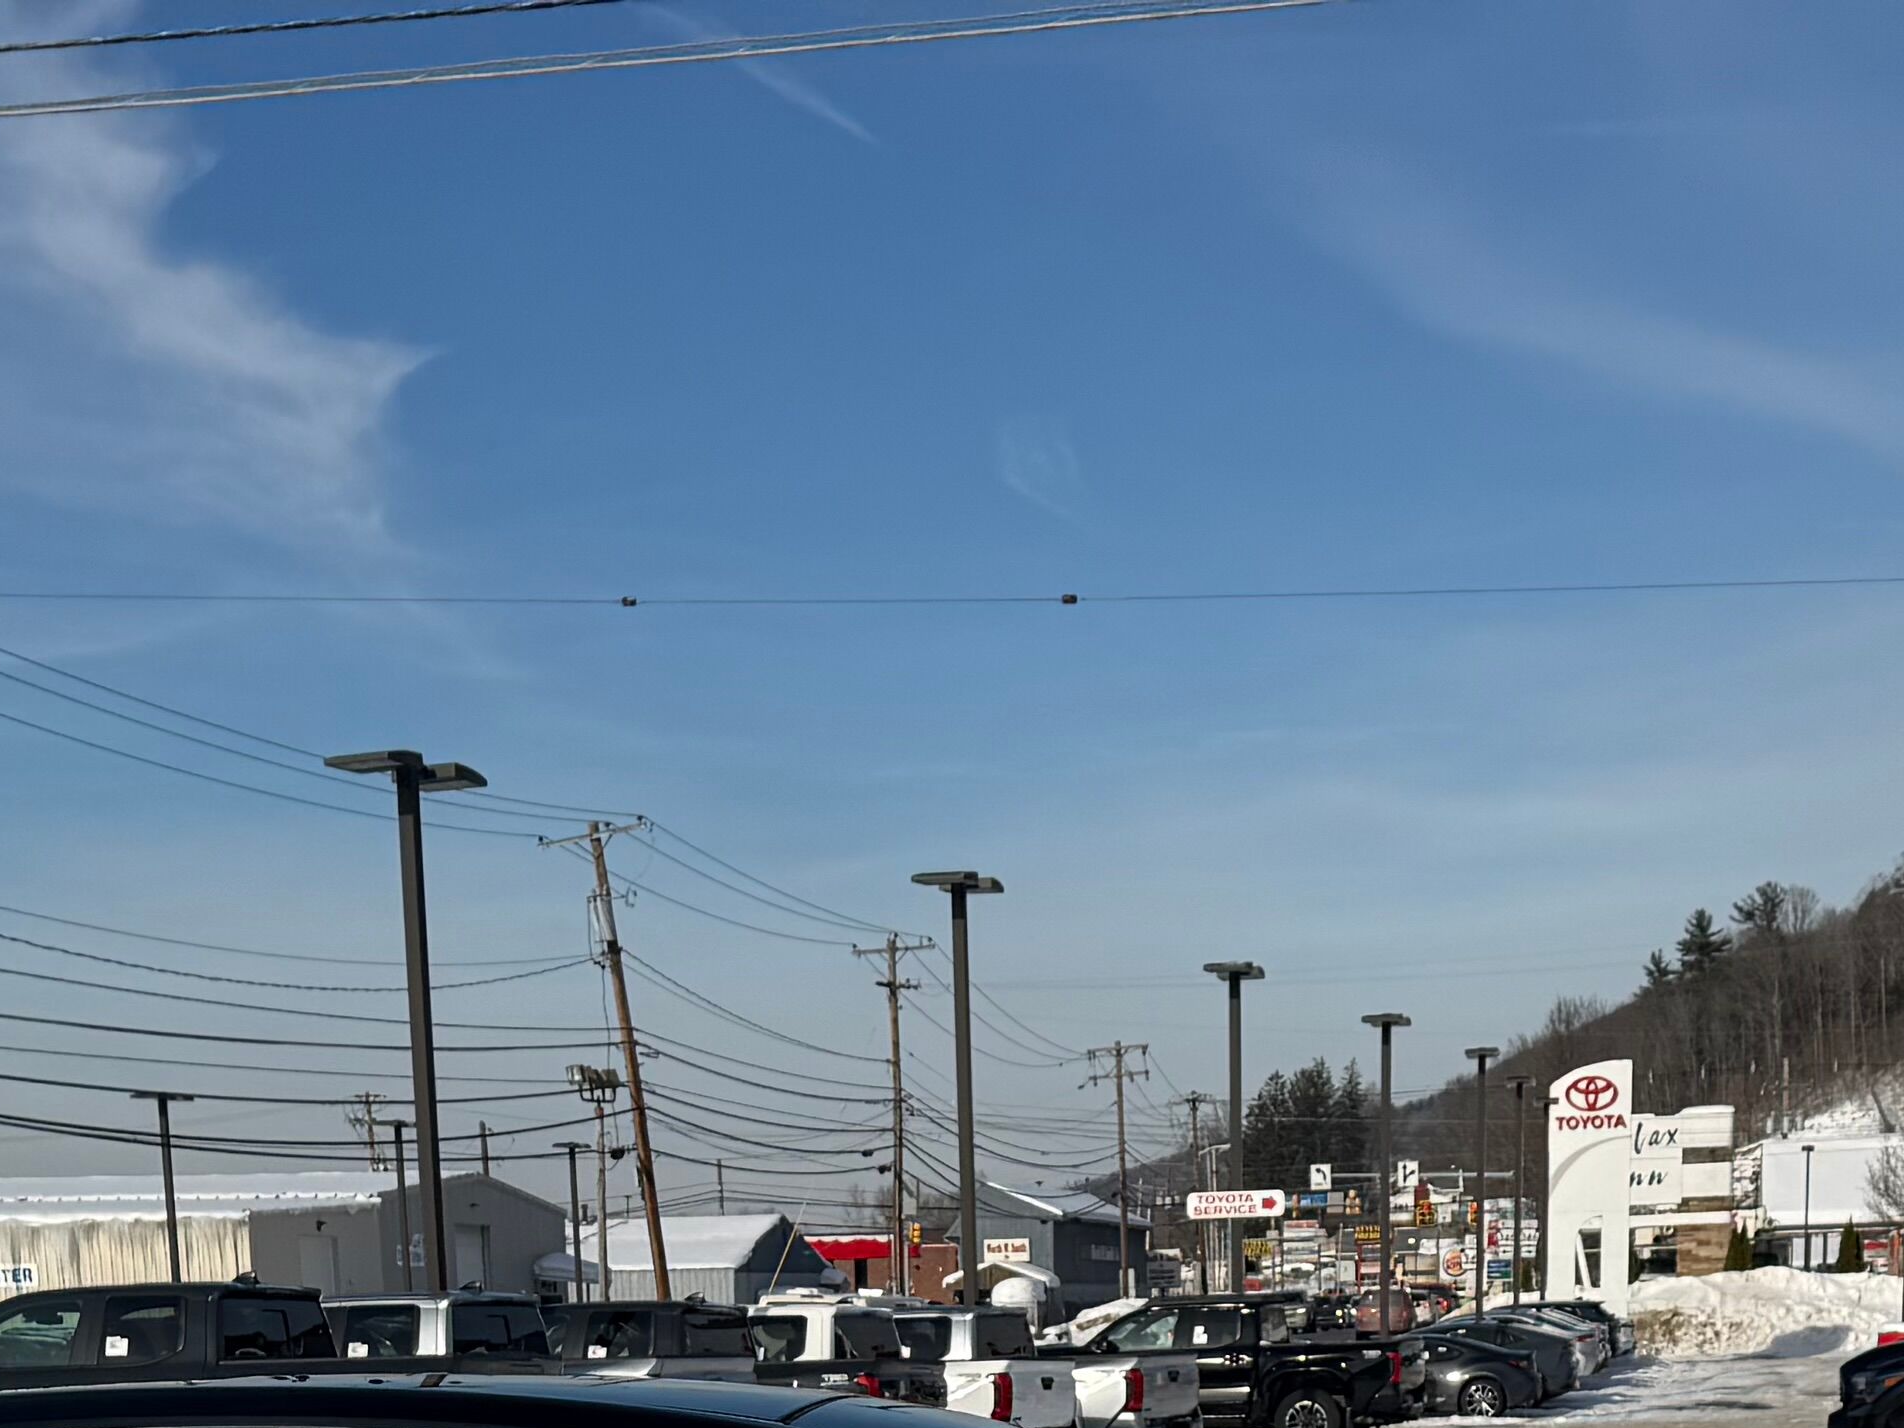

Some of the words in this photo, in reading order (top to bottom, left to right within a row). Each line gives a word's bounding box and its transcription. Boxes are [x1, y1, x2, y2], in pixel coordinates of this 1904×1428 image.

[1555, 1114, 1627, 1131] TOYOTA
[1197, 1194, 1254, 1204] TOYOTA
[1194, 1205, 1257, 1216] SERVICE
